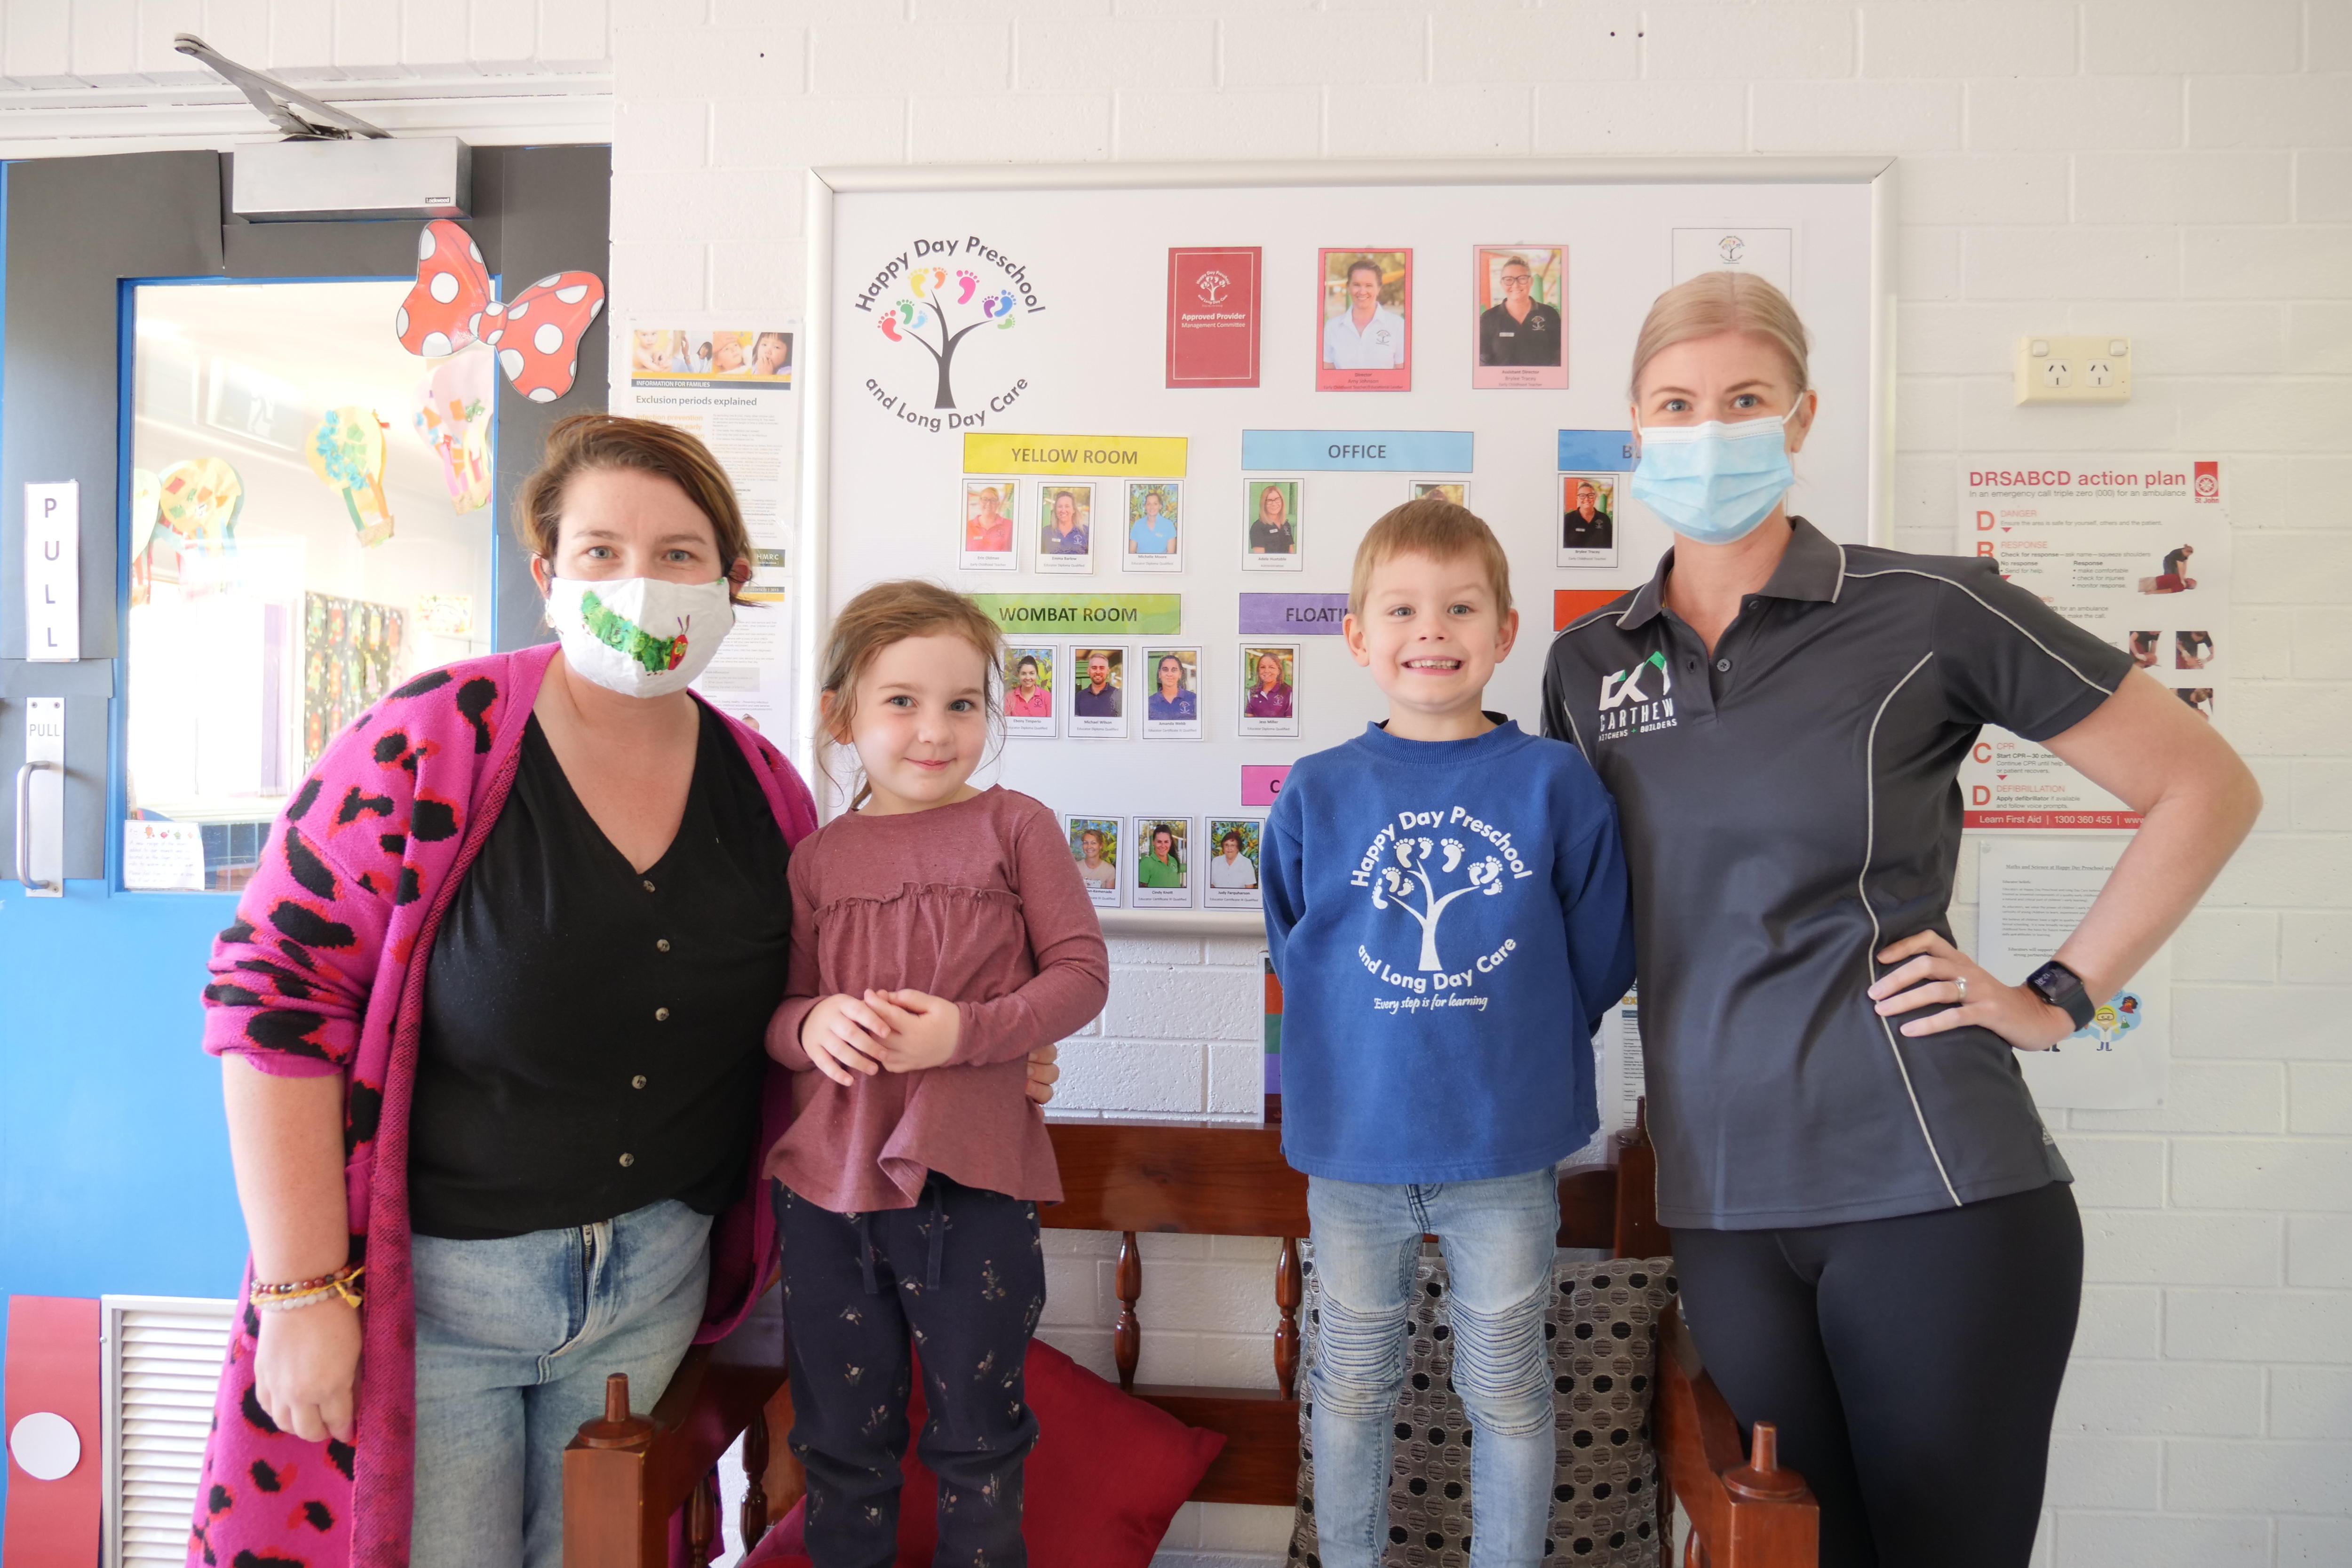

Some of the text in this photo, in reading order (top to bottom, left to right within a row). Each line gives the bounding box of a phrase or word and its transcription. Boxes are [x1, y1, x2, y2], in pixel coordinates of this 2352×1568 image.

[855, 236, 1046, 314] Happy Day Preschool
[636, 396, 757, 407] Exclusion periods explained
[866, 379, 1028, 433] and Long Day Care
[1011, 448, 1137, 465] YELLOW ROOM
[1327, 445, 1387, 459] OFFICE
[1970, 470, 2186, 489] DRSABCD action plan
[2054, 490, 2074, 499] triple
[2095, 489, 2115, 499] (000)
[1976, 510, 1995, 531] D
[44, 498, 60, 648] PULL
[999, 607, 1137, 622] WOMBAT ROOM
[1600, 698, 1674, 732] CARTHEW
[1640, 718, 1677, 733] BUILDERS
[29, 724, 60, 738] PULL
[1973, 742, 1992, 764] C
[1972, 785, 1991, 806] D
[1351, 805, 1533, 887] Happy Day Preschool
[1358, 938, 1517, 994] and Long Day Care
[1374, 993, 1488, 1015] Every step is for learning
